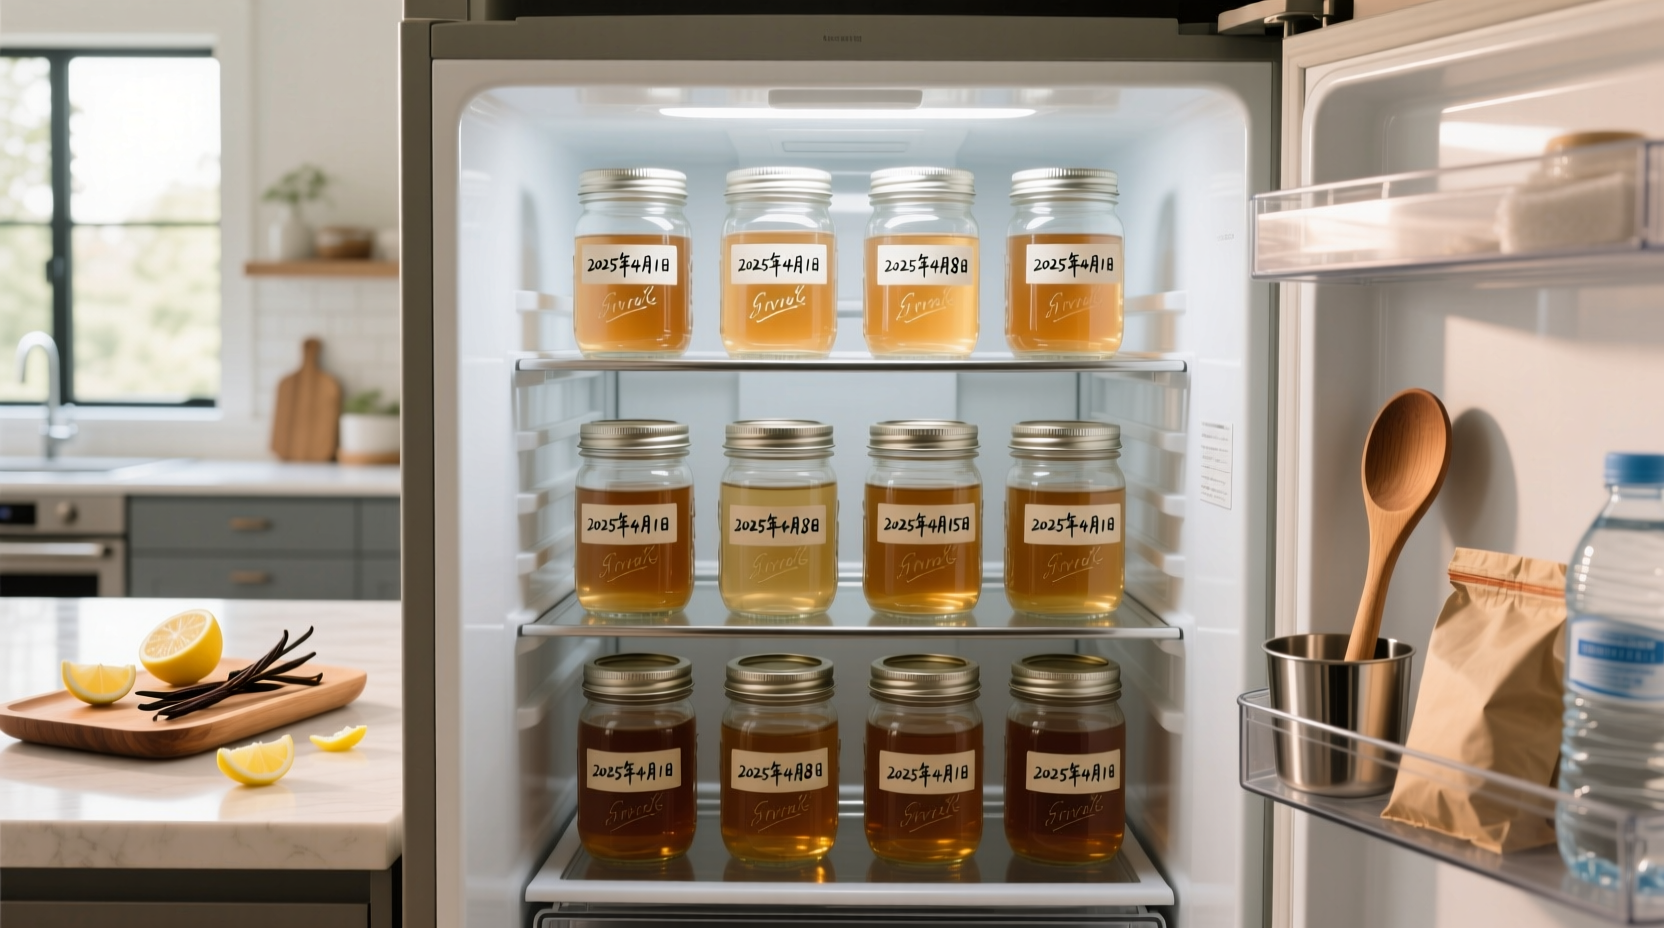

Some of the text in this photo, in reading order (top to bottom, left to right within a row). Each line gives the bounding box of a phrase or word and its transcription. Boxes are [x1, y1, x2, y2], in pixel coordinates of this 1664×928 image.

[587, 251, 670, 278] 2025年4月1日
[737, 252, 819, 278] 2025年4月1日
[884, 253, 968, 278] 2025年4月8日
[1033, 251, 1114, 278] 2025年4月1日
[587, 512, 669, 539] 2025年4月1日
[883, 512, 970, 538] 2025年4月15日
[1031, 512, 1115, 538] 2025年4月1日
[592, 760, 673, 785] 2025年4月1日
[737, 760, 823, 787] 2025年4月8日
[886, 761, 969, 788] 2025年4月1日
[1033, 762, 1115, 788] 2025年4月1日
